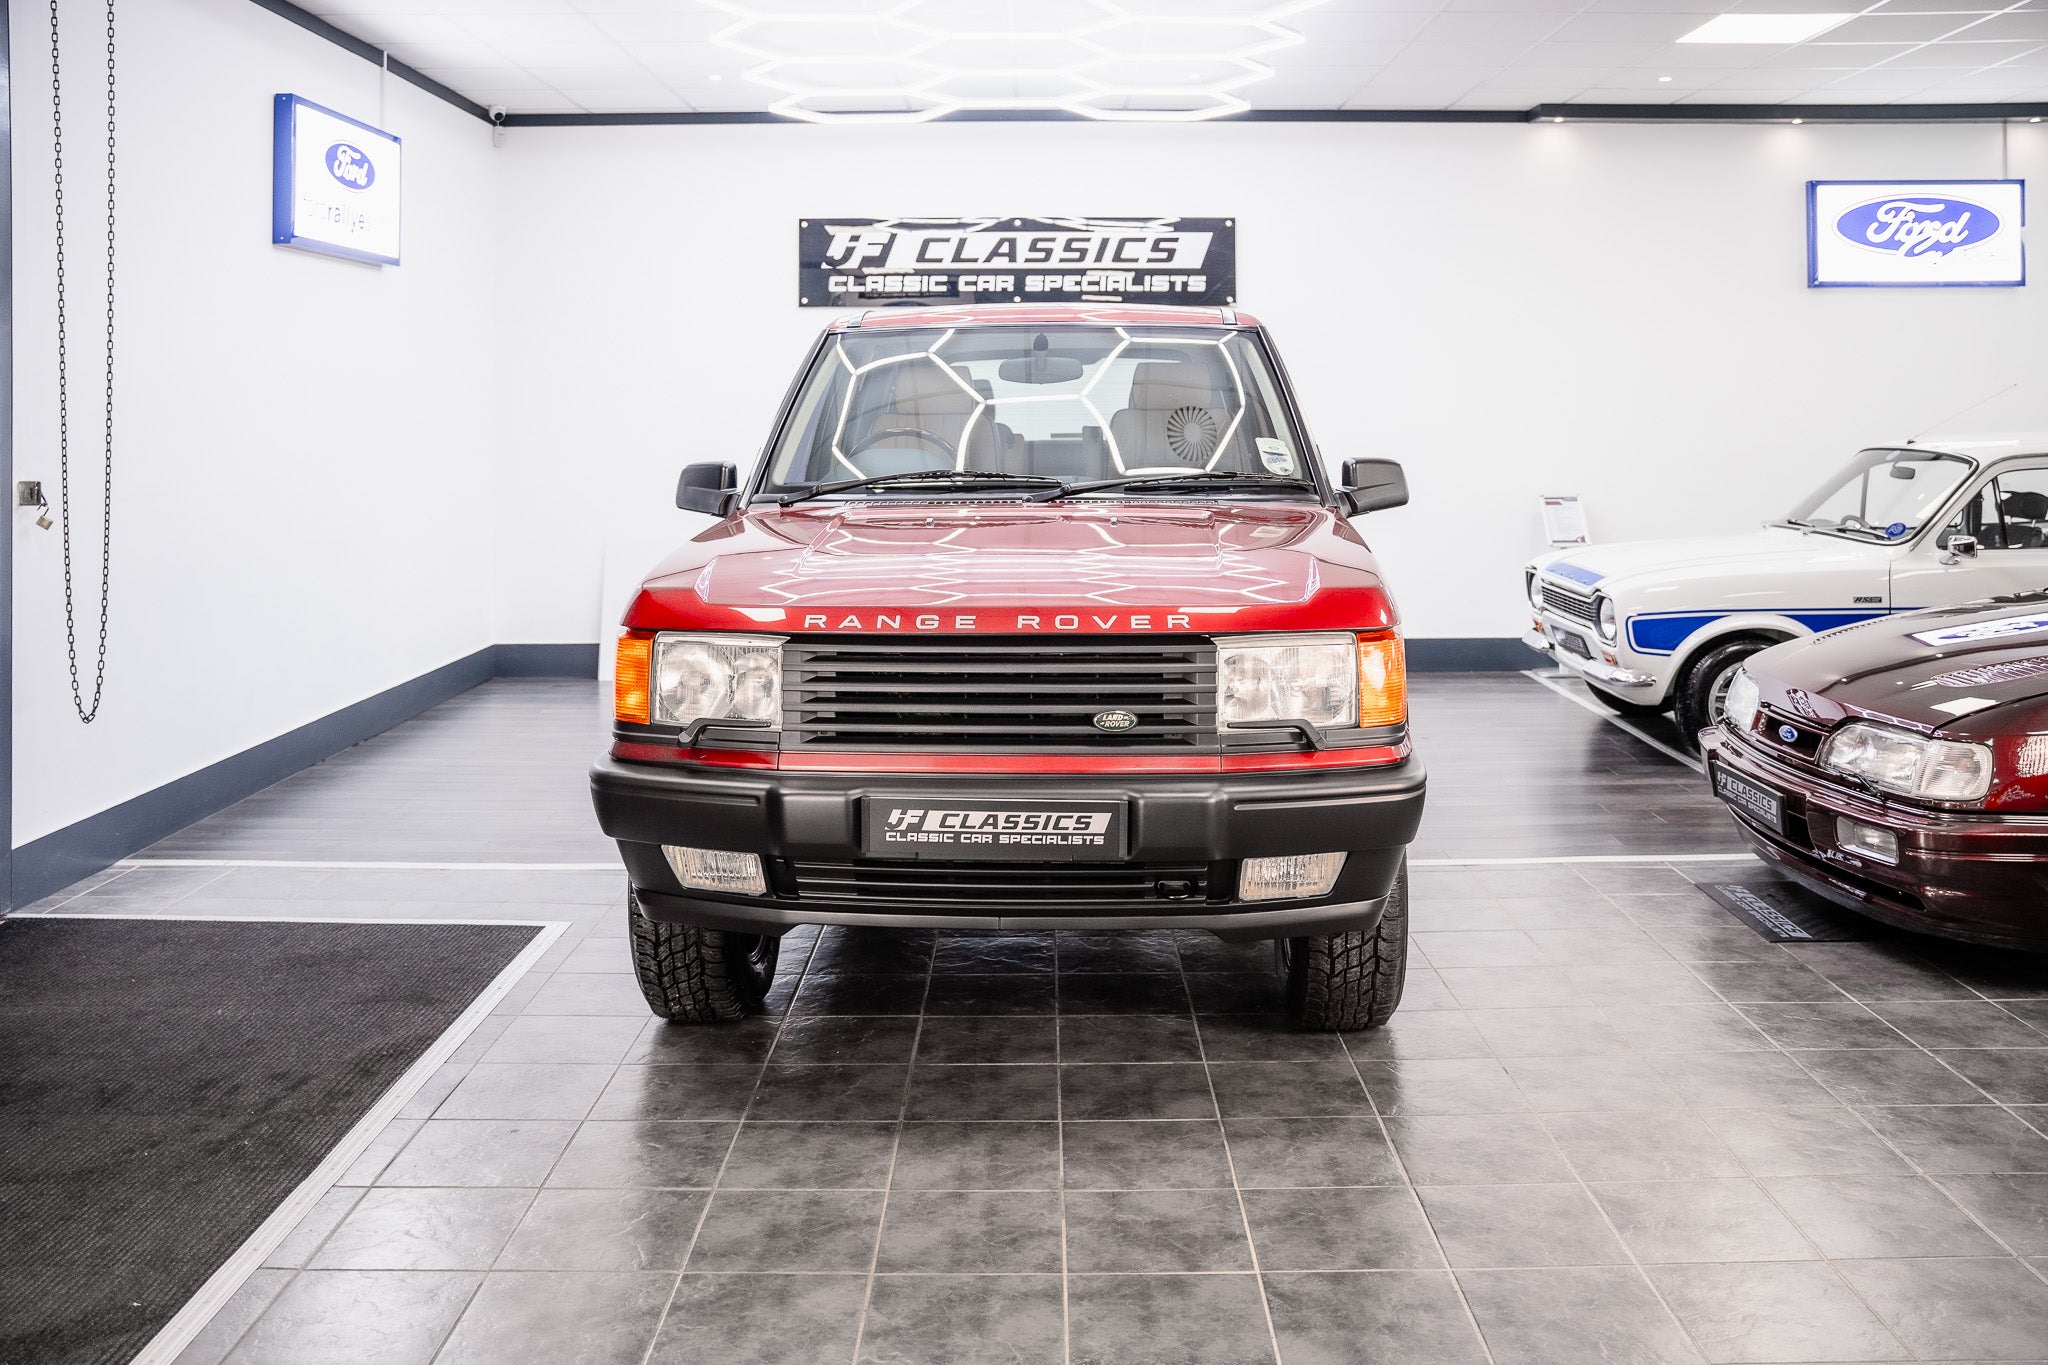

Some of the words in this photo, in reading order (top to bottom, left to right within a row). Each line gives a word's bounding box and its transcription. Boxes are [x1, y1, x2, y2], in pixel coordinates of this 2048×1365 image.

[333, 145, 369, 186] Ford
[1866, 200, 1972, 246] Ford
[916, 236, 1180, 264] CLASSICS
[828, 275, 948, 293] CLASSIC
[958, 275, 1014, 292] CAR
[1025, 274, 1207, 292] SPECIALISTS
[803, 614, 977, 630] RANGE
[1017, 613, 1191, 630] ROVER
[1102, 713, 1124, 721] LAND
[1104, 720, 1130, 728] ROVER
[1730, 780, 1772, 811] CLASSICS
[938, 813, 1093, 831] CLASSICS
[885, 832, 954, 843] CLASSIC
[960, 833, 993, 844] CAR
[999, 835, 1105, 845] SPECIALISTS
